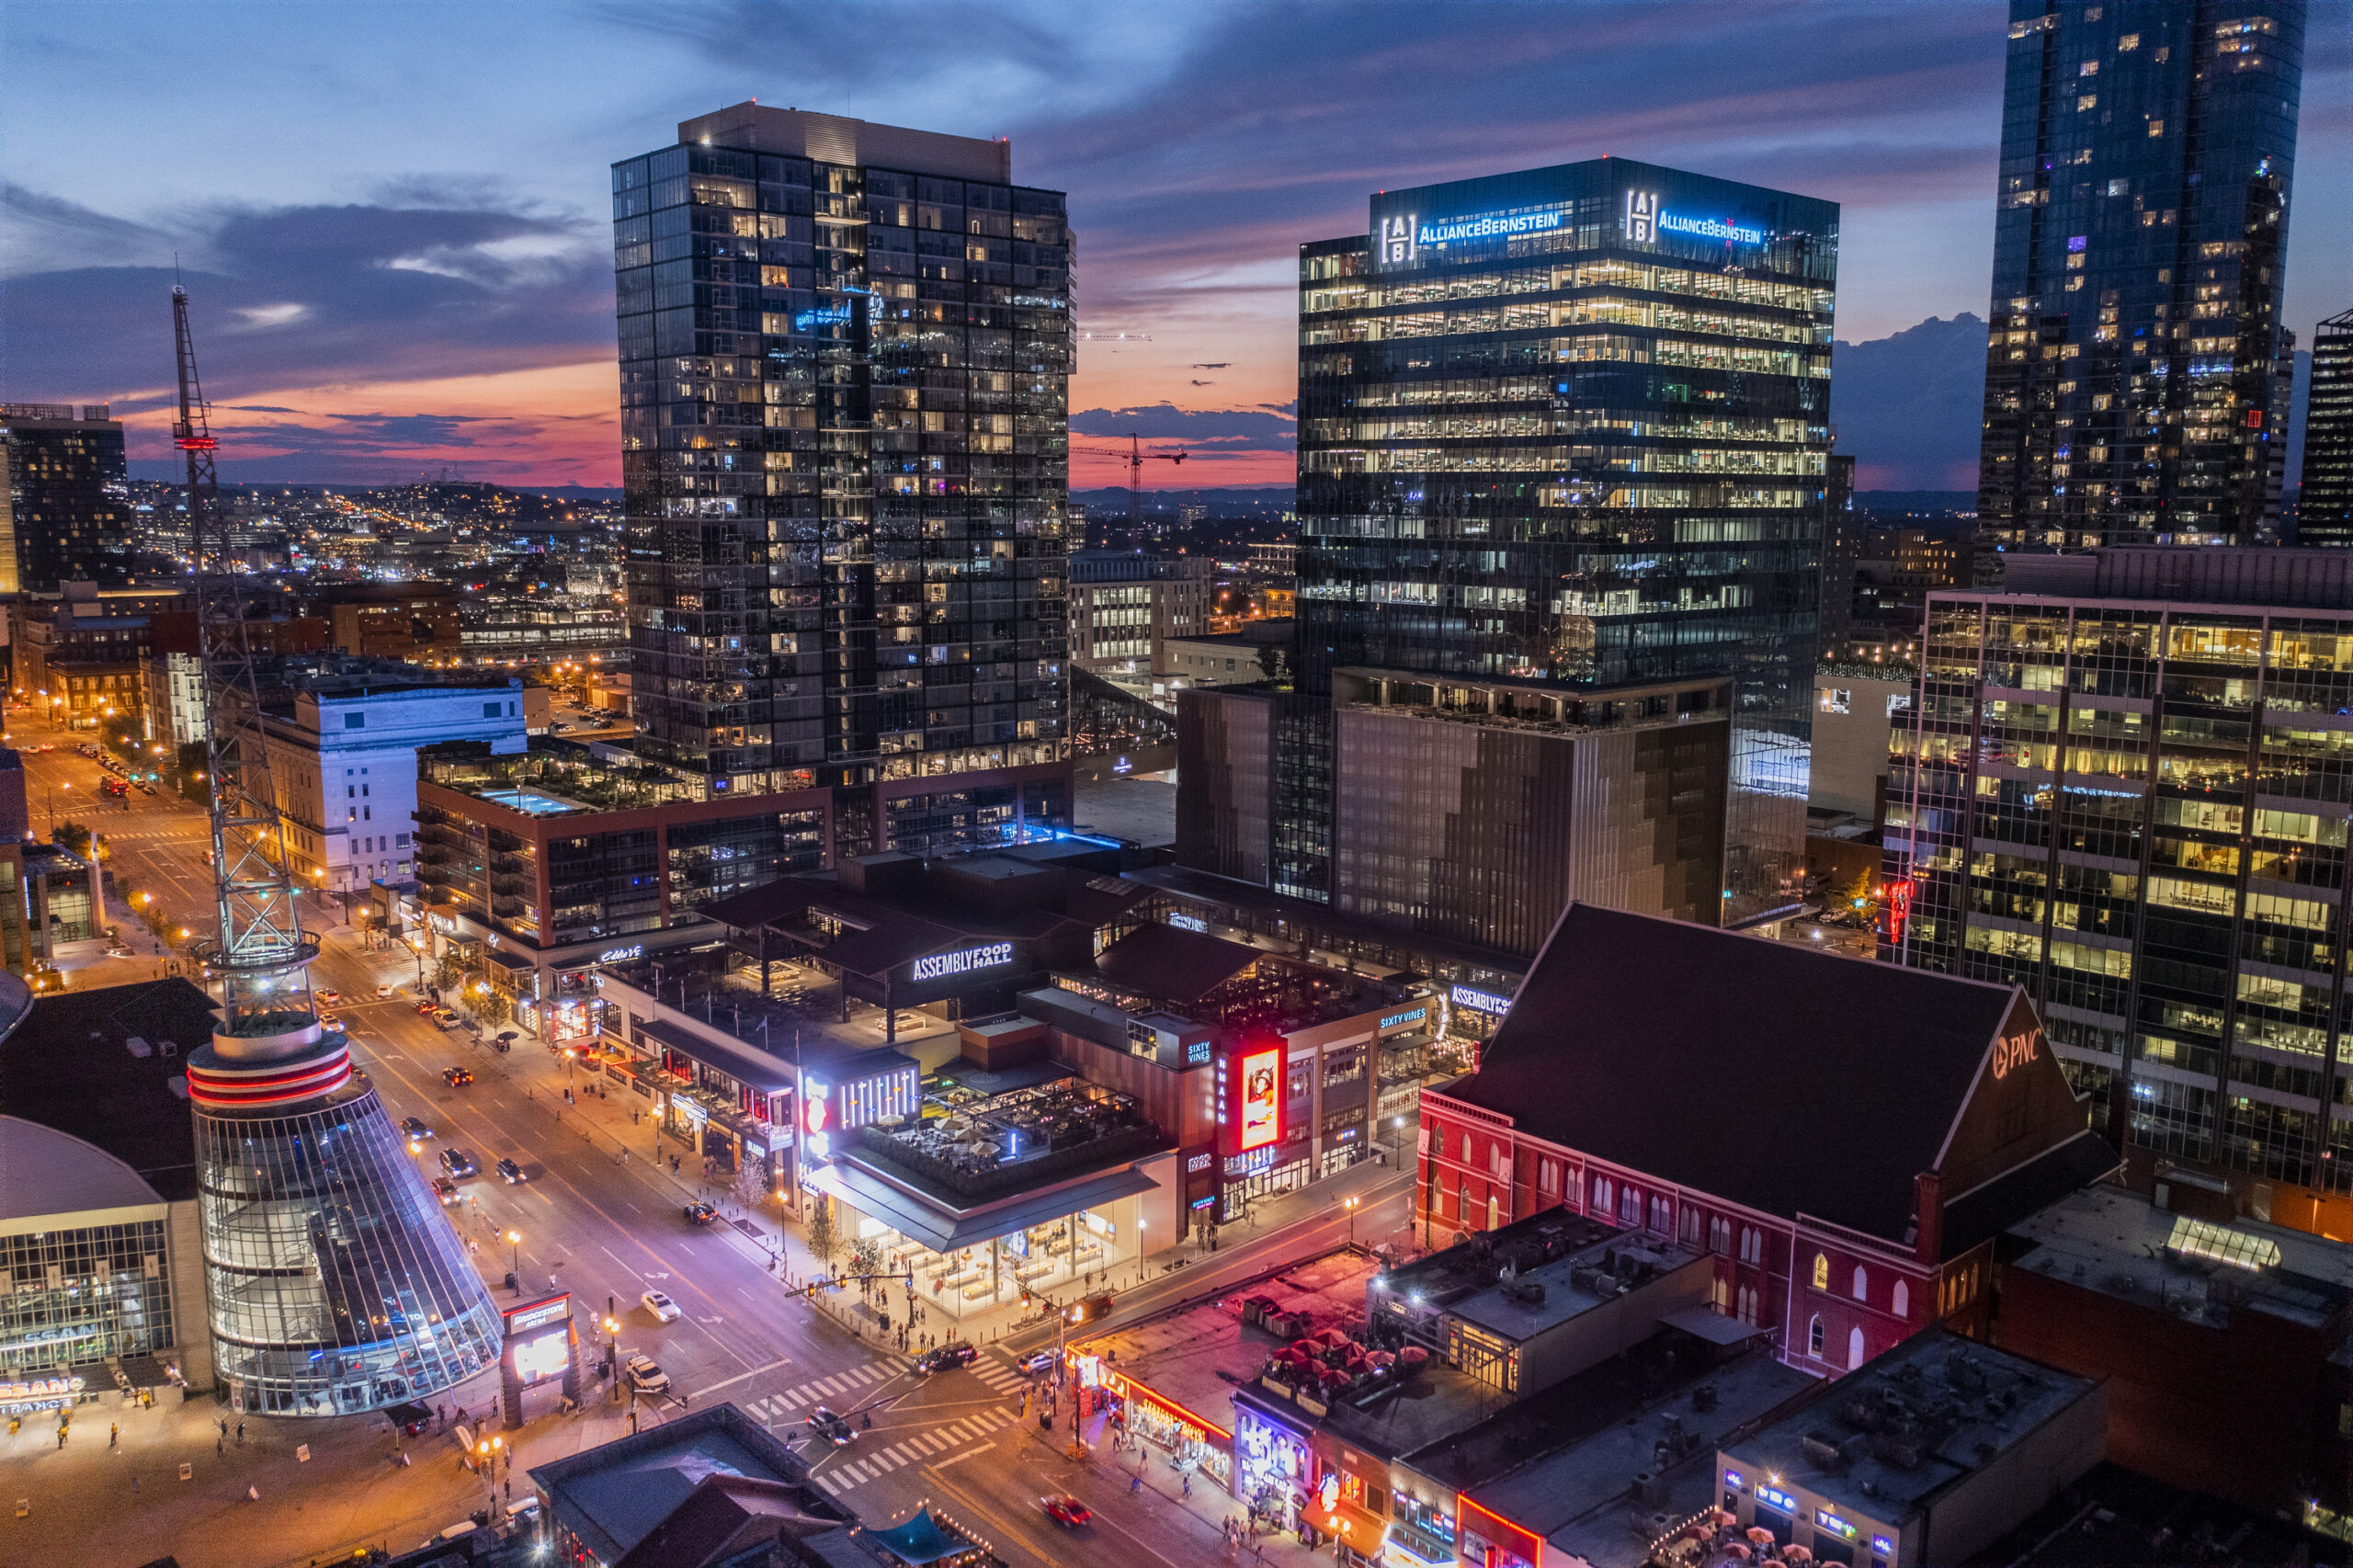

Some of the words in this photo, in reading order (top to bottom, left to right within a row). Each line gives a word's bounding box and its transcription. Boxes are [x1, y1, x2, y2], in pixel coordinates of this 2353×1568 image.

[913, 949, 973, 981] ASSEMBLY
[973, 943, 1012, 959] FOOD
[973, 953, 1012, 969] HALL
[1452, 985, 1495, 1013] ASSEMBLY
[1381, 1014, 1404, 1028] SIXTY
[1404, 1007, 1426, 1023] VINES
[1188, 1040, 1210, 1054] SIXTY
[1188, 1050, 1210, 1062] VINES
[2009, 1028, 2042, 1069] PNC
[1218, 1058, 1226, 1124] NMAAM
[514, 1302, 566, 1325] BRIDGESTONE
[526, 1316, 546, 1328] ARENA
